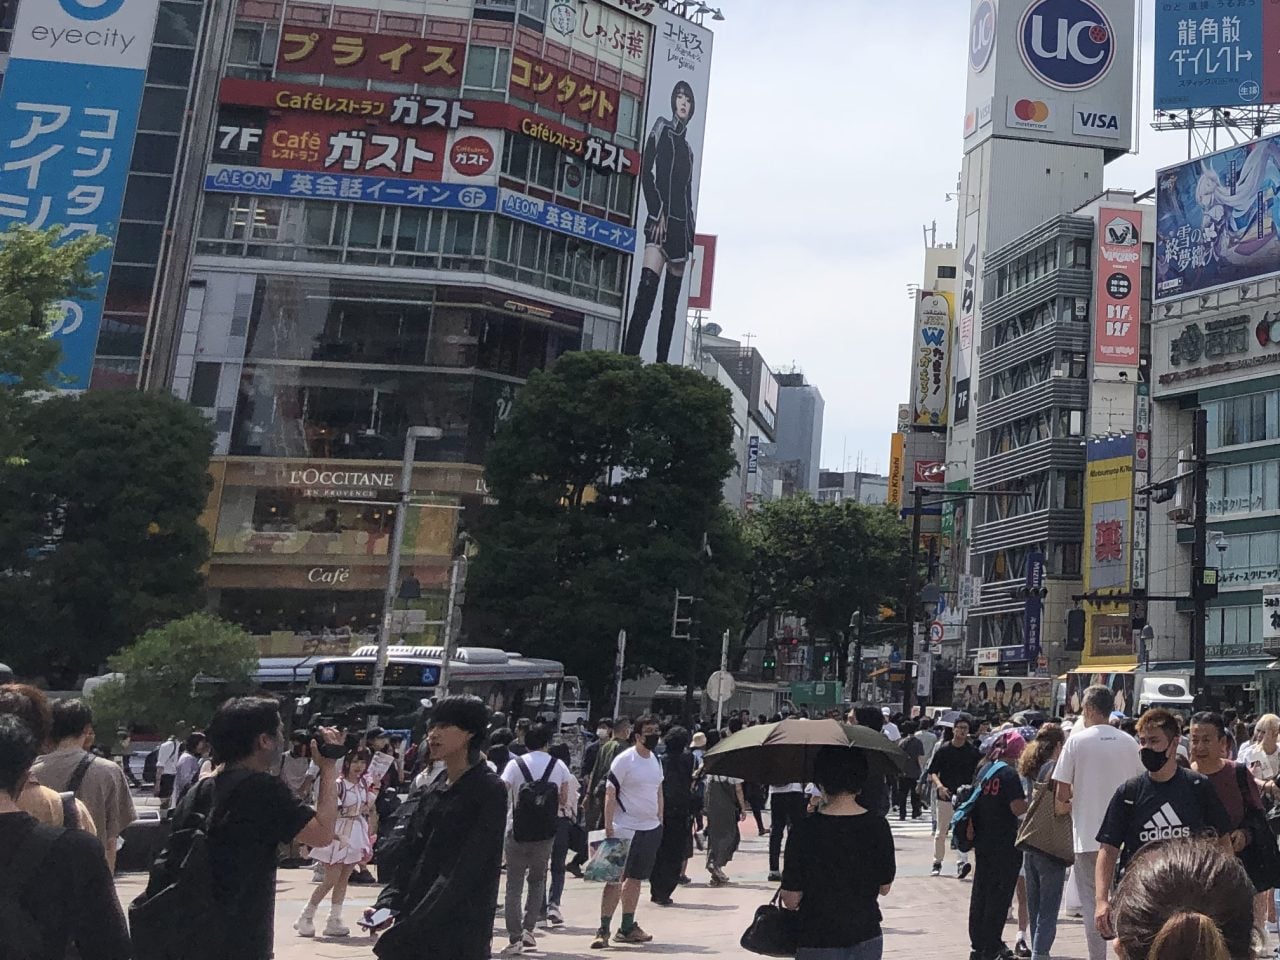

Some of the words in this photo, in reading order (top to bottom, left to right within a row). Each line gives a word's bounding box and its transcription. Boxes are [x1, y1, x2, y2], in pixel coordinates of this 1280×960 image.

[31, 23, 136, 55] eyecity
[583, 8, 644, 59] しゃぶ葉
[1178, 15, 1241, 46] 龍角散
[283, 32, 456, 75] プライス
[1168, 46, 1253, 76] ダイレクト
[511, 56, 614, 119] コンタクト
[390, 95, 475, 128] ガスト
[1077, 111, 1119, 130] VISA
[1015, 121, 1048, 129] mastercard
[219, 126, 262, 151] 7F
[272, 129, 321, 149] Café
[271, 149, 318, 162] レストラン
[323, 130, 434, 173] ガスト
[455, 152, 489, 166] ガスト
[584, 136, 631, 174] ガスト
[215, 170, 272, 188] AEON
[289, 173, 450, 204] 英会話イーオン
[461, 189, 484, 206] 6F
[506, 195, 539, 218] AEON
[545, 206, 635, 246] 英会話イーオン
[1107, 304, 1131, 320] B1F
[1106, 320, 1131, 337] B2F
[289, 468, 394, 487] L'OCCITANE
[308, 567, 349, 586] Café
[1139, 825, 1191, 843] adidas
